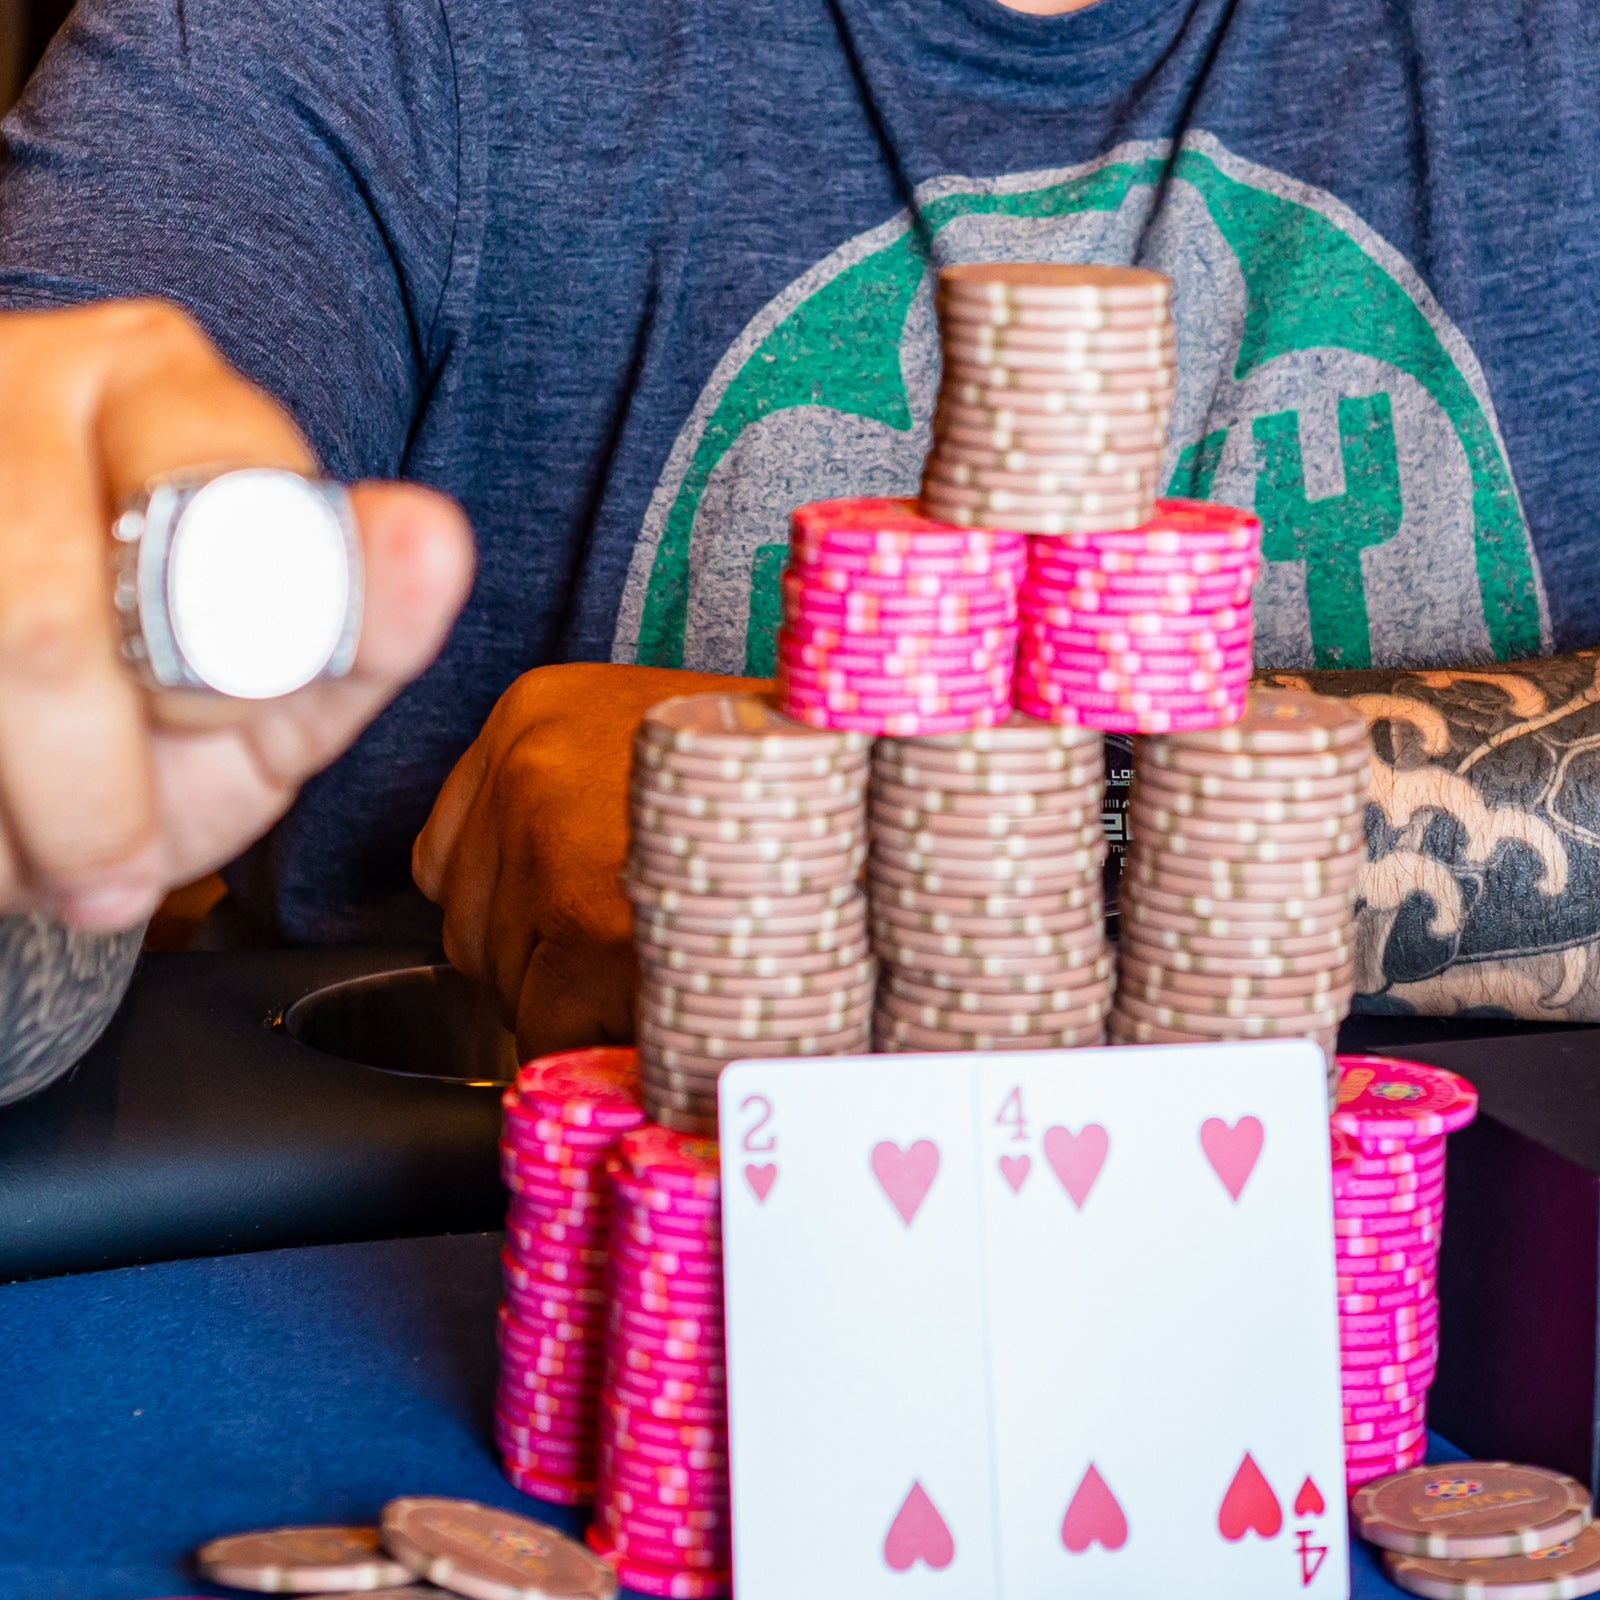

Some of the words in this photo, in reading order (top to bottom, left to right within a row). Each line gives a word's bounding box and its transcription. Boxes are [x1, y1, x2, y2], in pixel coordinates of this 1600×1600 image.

[740, 1095, 777, 1152] 2
[995, 1086, 1029, 1140] 4
[1293, 1528, 1329, 1588] 4
